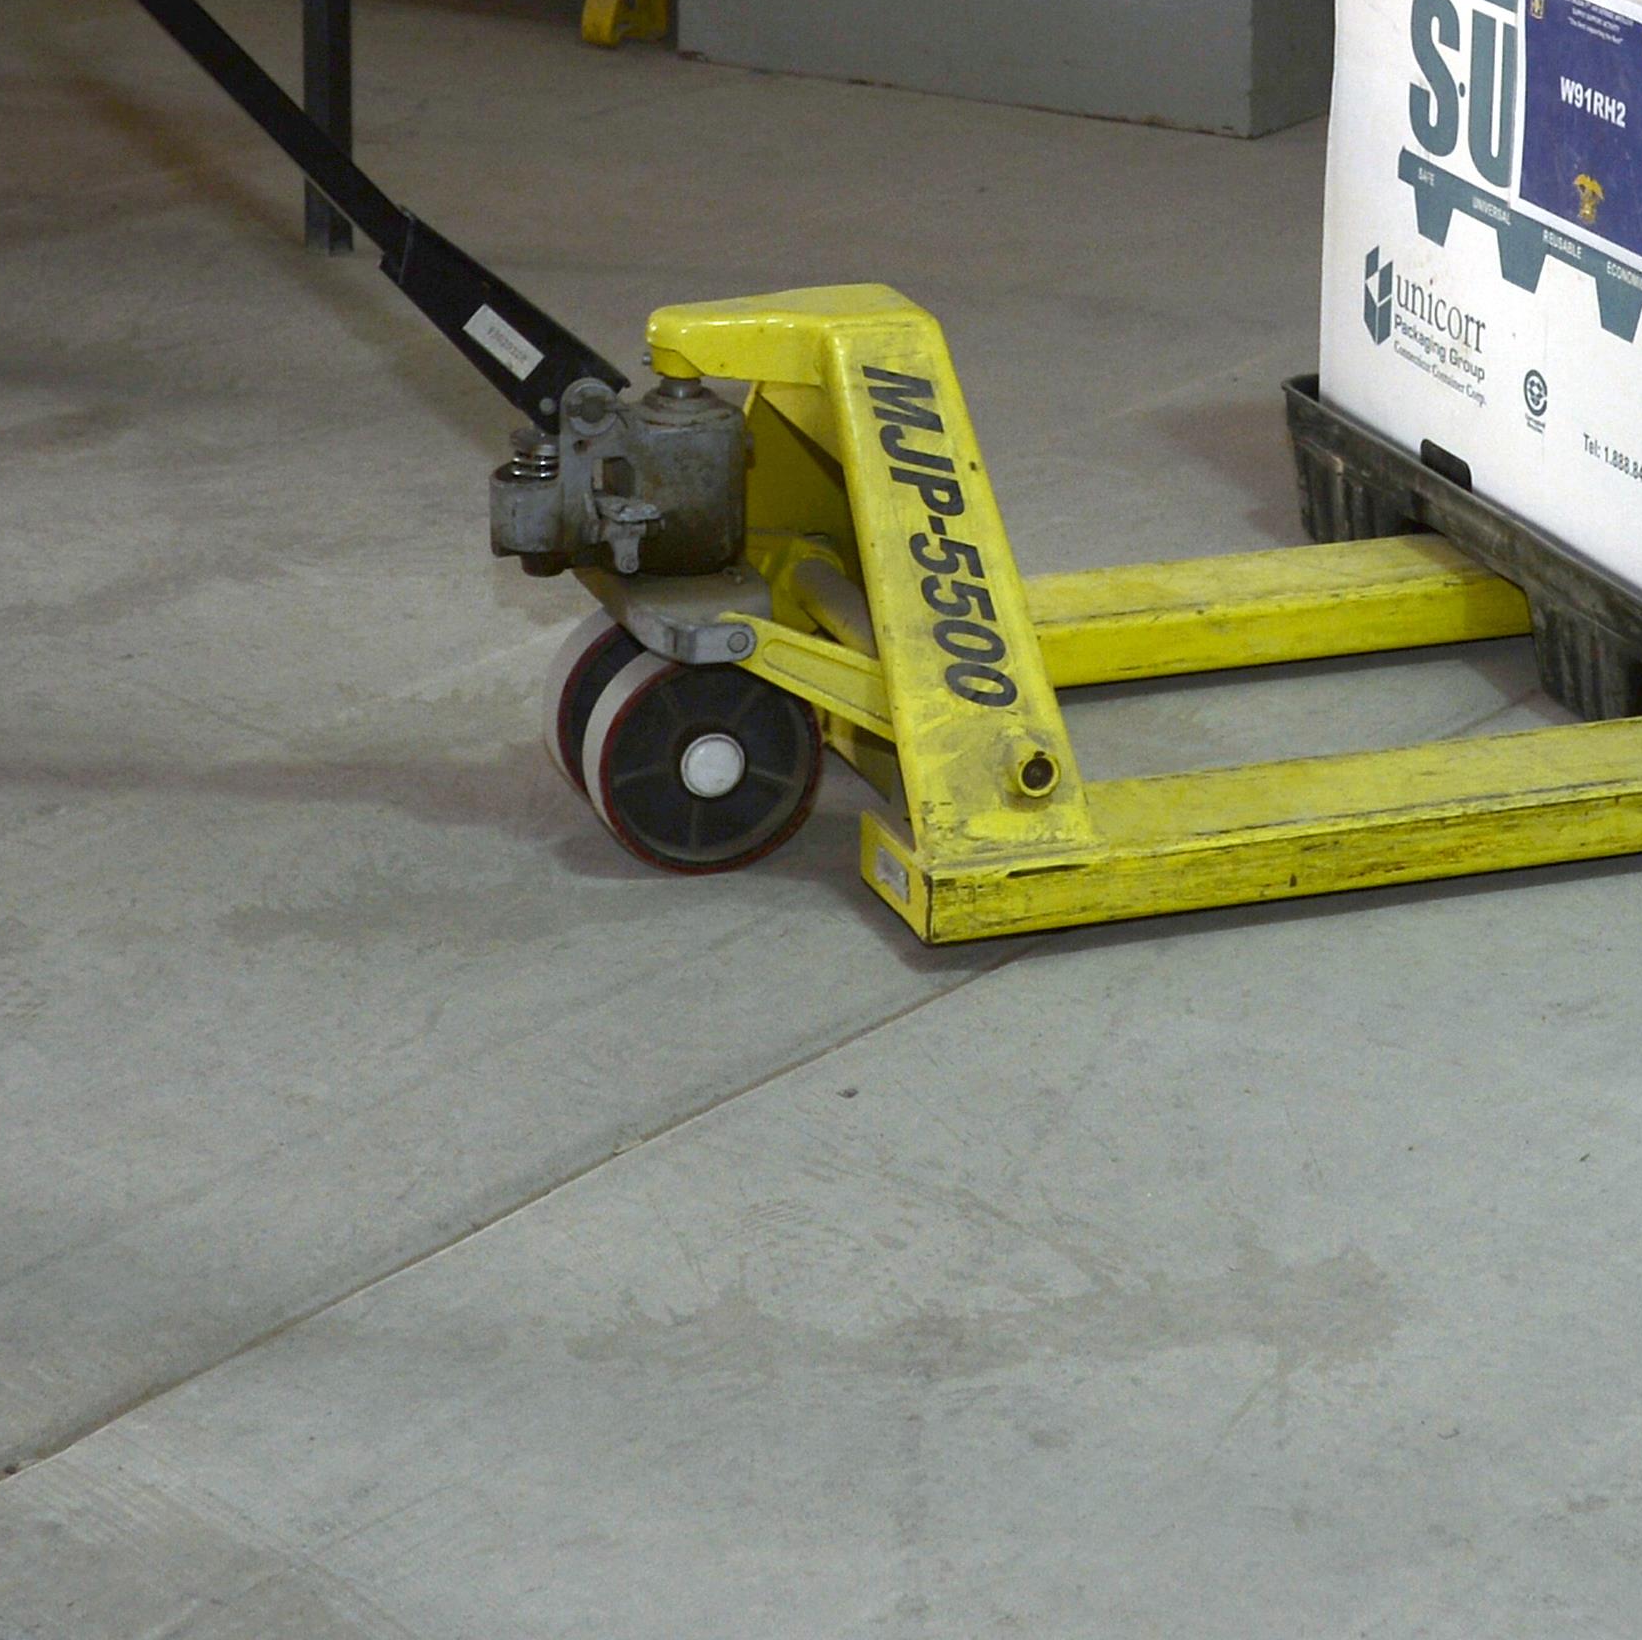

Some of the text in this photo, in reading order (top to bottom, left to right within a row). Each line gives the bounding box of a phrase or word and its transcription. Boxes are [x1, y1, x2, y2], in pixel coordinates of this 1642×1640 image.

[1560, 75, 1626, 130] W91RH2
[1542, 228, 1583, 260] REUSABLE
[1396, 273, 1487, 354] unicorr
[1394, 315, 1486, 382] Packaging Group
[1583, 433, 1601, 459] Tel:
[861, 363, 1018, 708] MJP-5500
